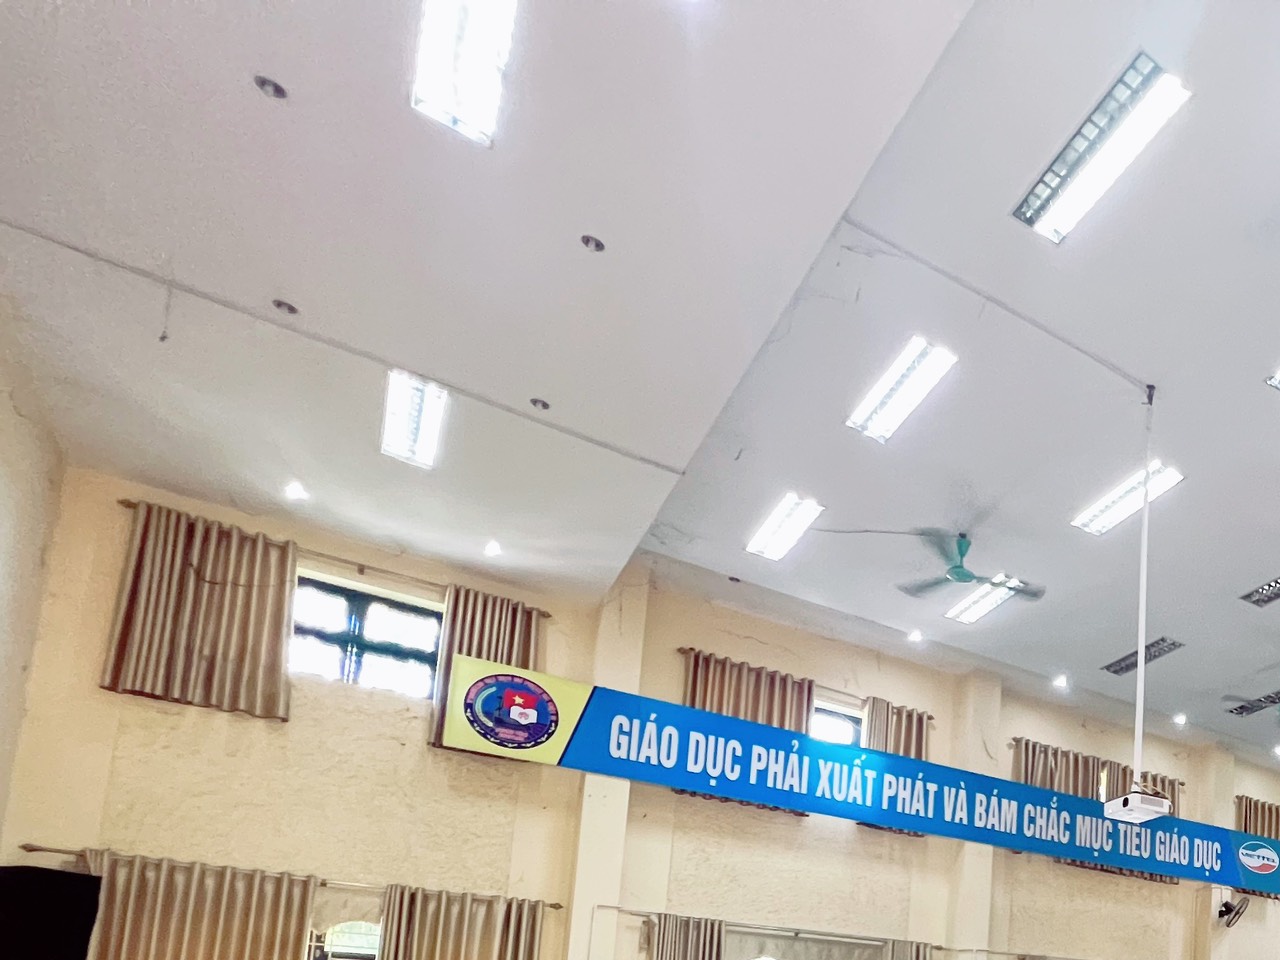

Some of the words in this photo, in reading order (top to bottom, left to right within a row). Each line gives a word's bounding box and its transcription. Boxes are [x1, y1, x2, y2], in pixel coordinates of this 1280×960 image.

[608, 713, 680, 769] GIÁO
[686, 730, 743, 787] DỤC
[749, 739, 811, 795] PHẢI
[815, 754, 878, 807] XUẤT
[882, 772, 938, 819] PHÁT
[943, 781, 968, 825] VÀ
[974, 789, 1018, 835] BÁM
[1023, 796, 1071, 844] CHẮC
[1075, 813, 1114, 857] MỤC
[1155, 827, 1190, 866] GIÁO
[1193, 837, 1222, 876] DỤC
